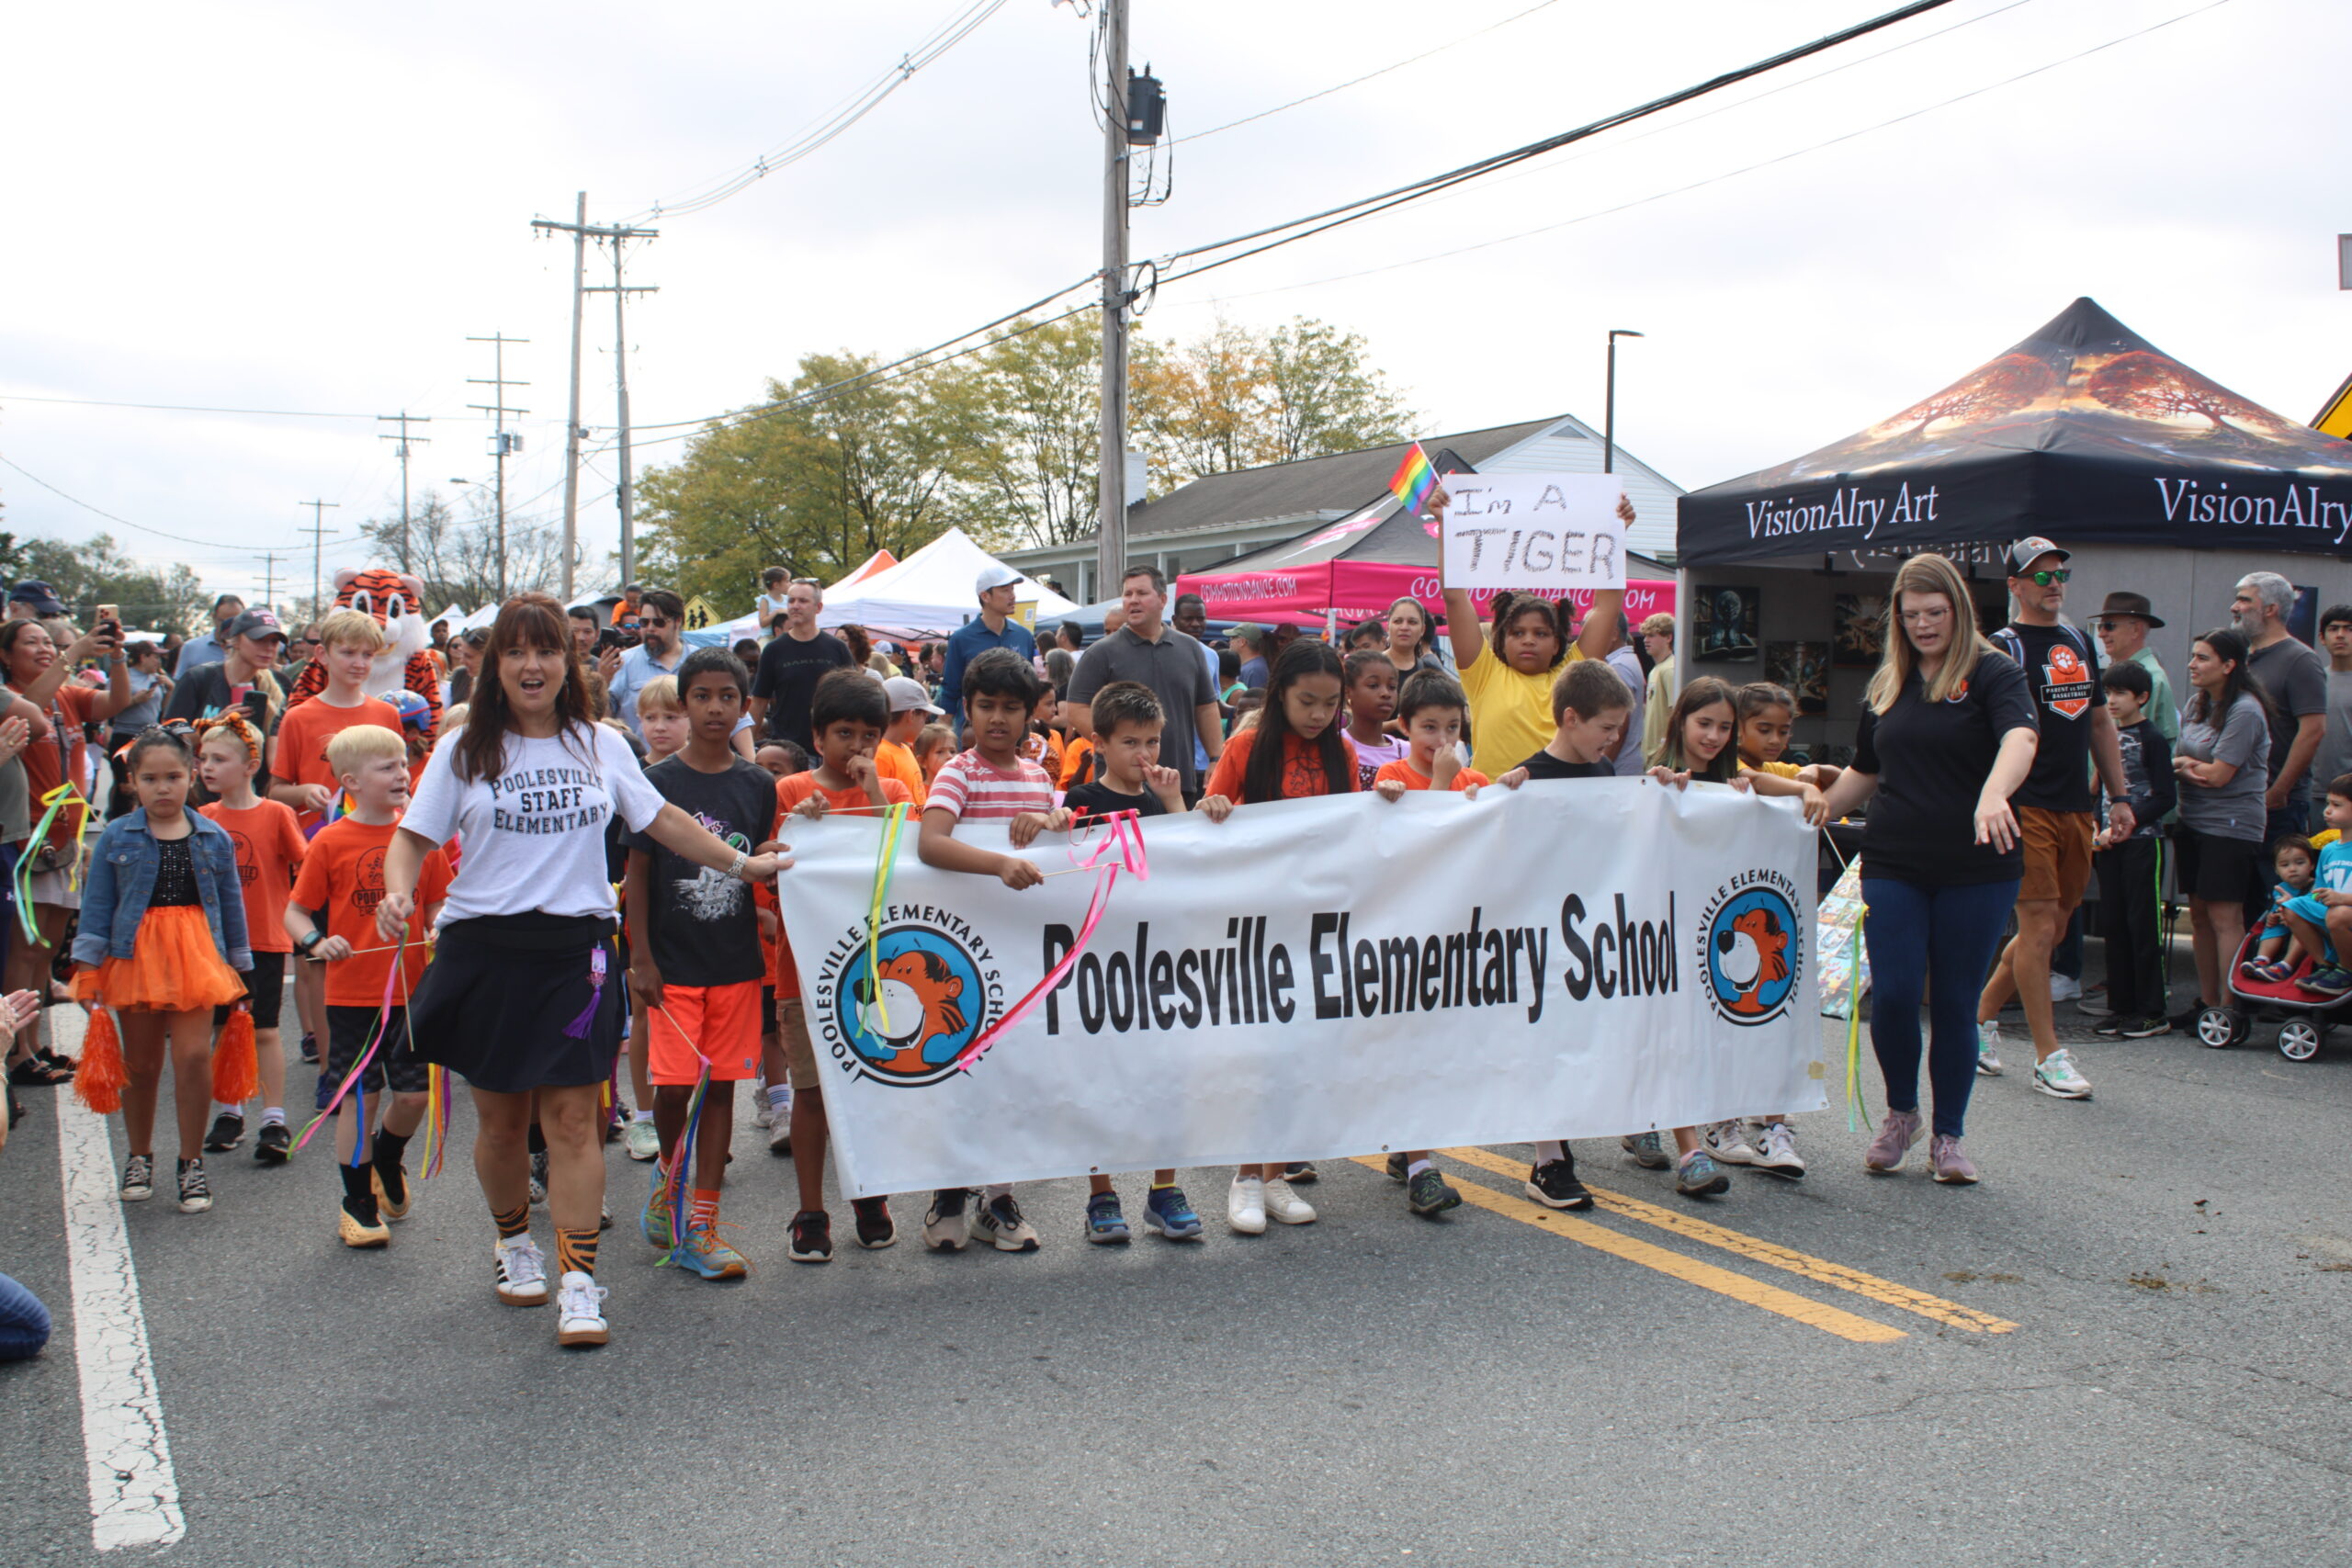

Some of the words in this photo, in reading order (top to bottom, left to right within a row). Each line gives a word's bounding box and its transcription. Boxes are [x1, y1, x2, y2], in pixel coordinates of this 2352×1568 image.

[1533, 484, 1567, 512] A
[1889, 480, 1939, 524] Art
[1455, 527, 1617, 580] TIGER
[1200, 577, 1298, 604] COMMOTIONDANCE.COM
[2045, 686, 2068, 694] PARENT
[2052, 691, 2086, 699] BASKETBALL
[490, 768, 604, 800] POOLESVILLE
[521, 787, 582, 813] STAFF
[494, 802, 607, 834] ELEMENTARY
[1697, 885, 1728, 1011] POOLESVILLE
[1730, 868, 1803, 919] ELEMENTARY
[1787, 926, 1804, 1004] SCHOOL
[1043, 915, 1296, 1035] Poolesville
[1310, 906, 1548, 1024] Elementary
[1562, 890, 1679, 1001] School
[817, 926, 863, 1073] POOLESVILLE
